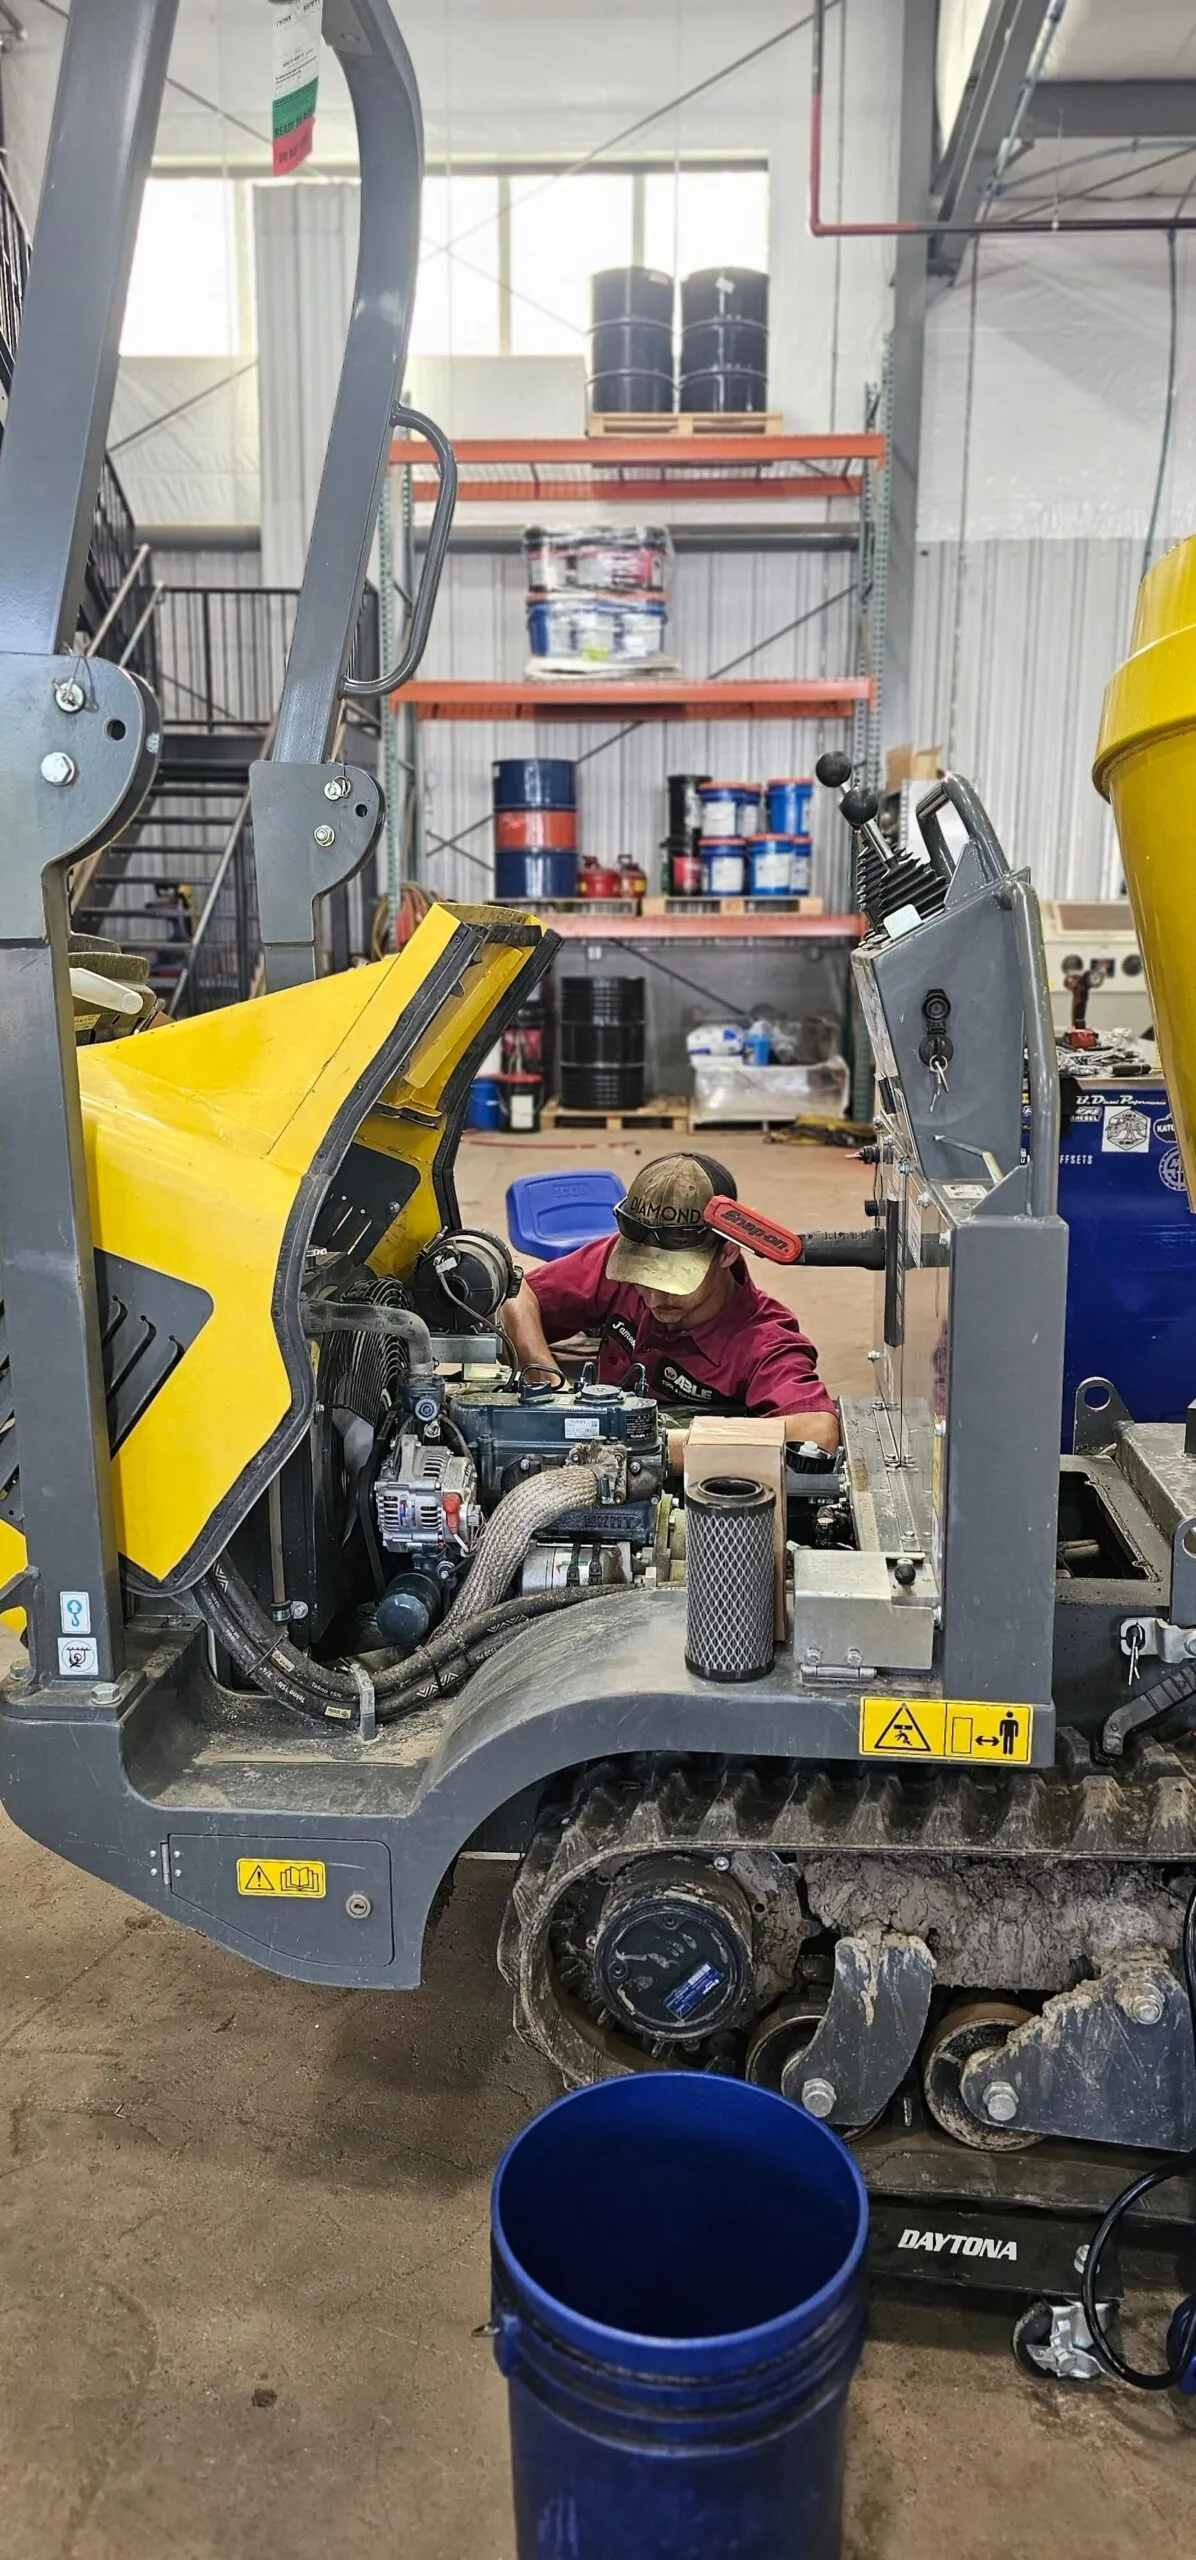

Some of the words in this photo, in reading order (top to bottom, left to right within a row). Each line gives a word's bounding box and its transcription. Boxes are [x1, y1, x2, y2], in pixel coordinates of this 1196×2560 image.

[1060, 1154, 1093, 1165] FFSETS
[630, 1198, 700, 1225] DIAMOND
[720, 1208, 788, 1251] Snap-on
[674, 1374, 713, 1400] ABLE
[288, 1689, 306, 1704] Tekno
[311, 1681, 329, 1694] Tekno
[898, 2229, 1017, 2260] DAYTONA
